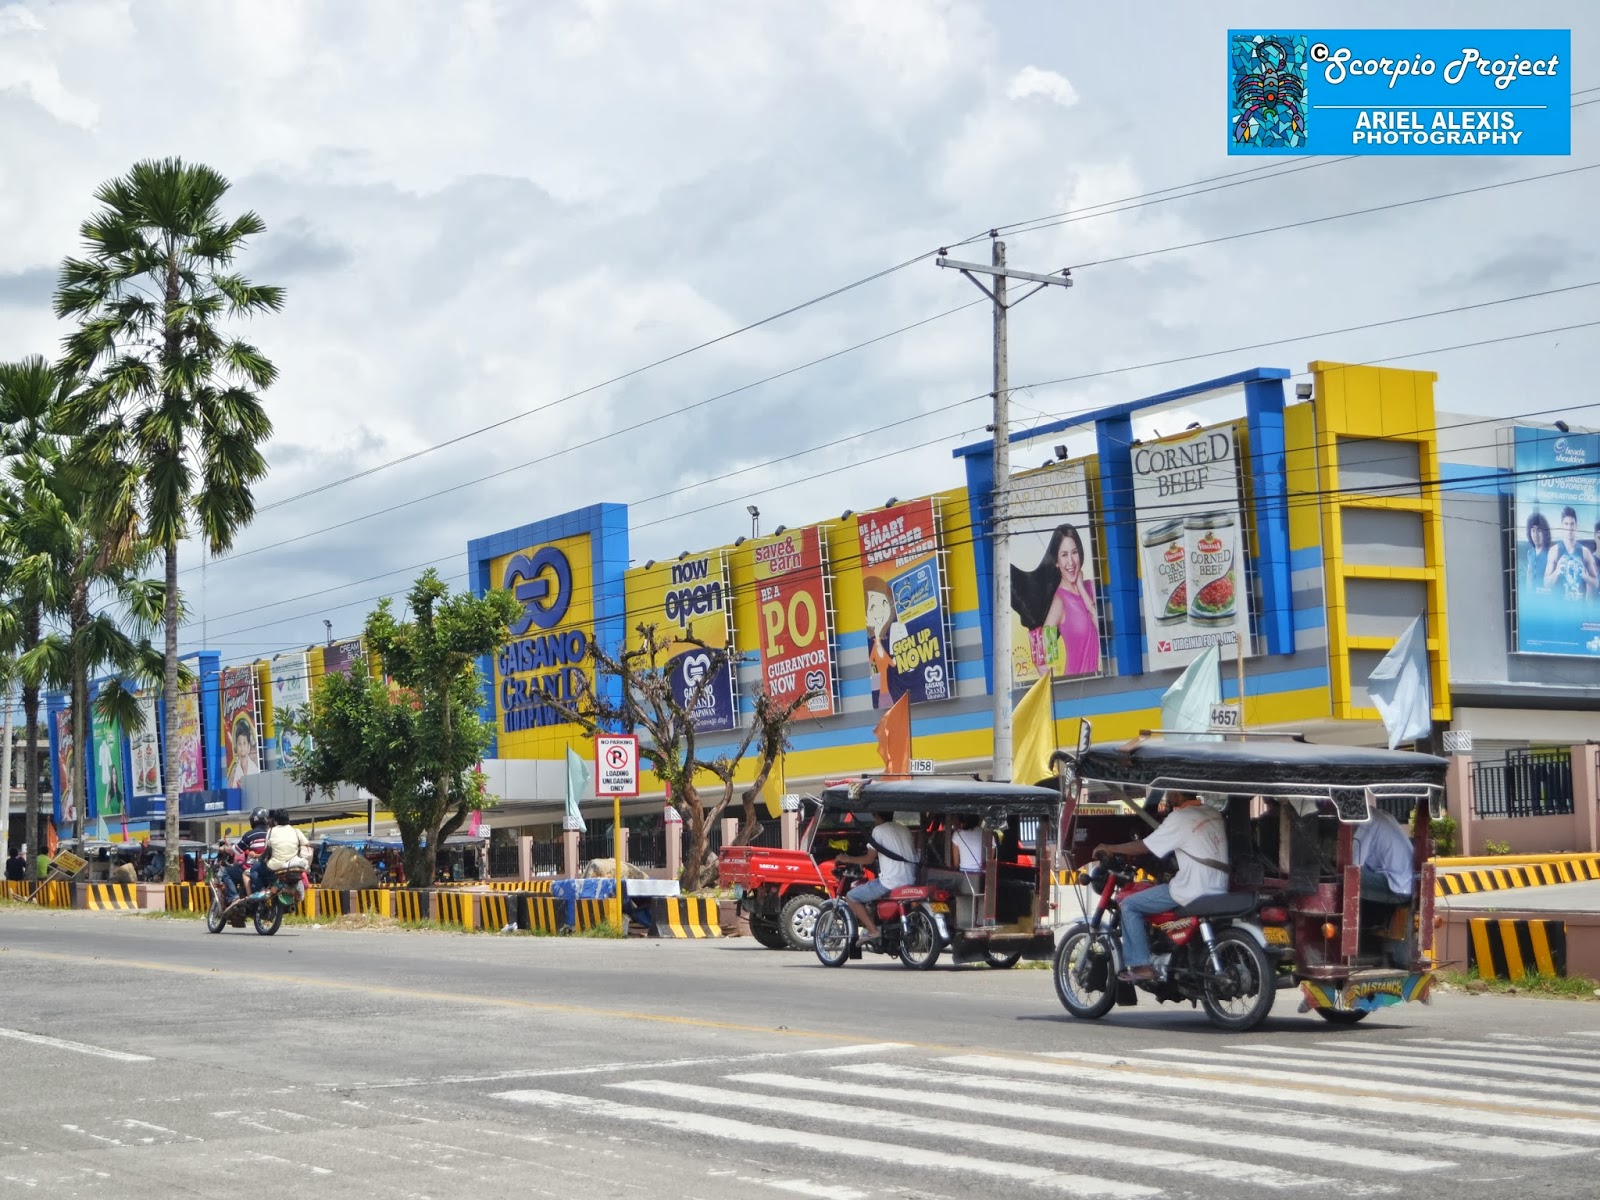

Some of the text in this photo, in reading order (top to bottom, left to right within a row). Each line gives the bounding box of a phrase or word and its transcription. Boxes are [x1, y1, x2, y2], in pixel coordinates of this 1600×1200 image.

[1134, 433, 1229, 475] CORNED
[1156, 466, 1209, 497] BEEF
[859, 523, 869, 536] BE
[863, 515, 905, 551] SMART
[755, 535, 796, 563] save&
[867, 526, 923, 568] SHOPPER
[1190, 549, 1231, 565] CORNED
[671, 557, 709, 585] now
[769, 552, 802, 574] earn
[1200, 564, 1224, 576] BEEF
[1168, 572, 1186, 584] BEE
[665, 581, 723, 628] open
[760, 585, 781, 602] BE A
[340, 642, 359, 654] CREAM
[498, 630, 587, 677] GAISANO
[893, 628, 931, 656] SIGN UP
[896, 636, 941, 675] NOW!
[767, 649, 827, 679] GUARANTOR
[1016, 661, 1028, 677] 25
[769, 673, 796, 697] NOW
